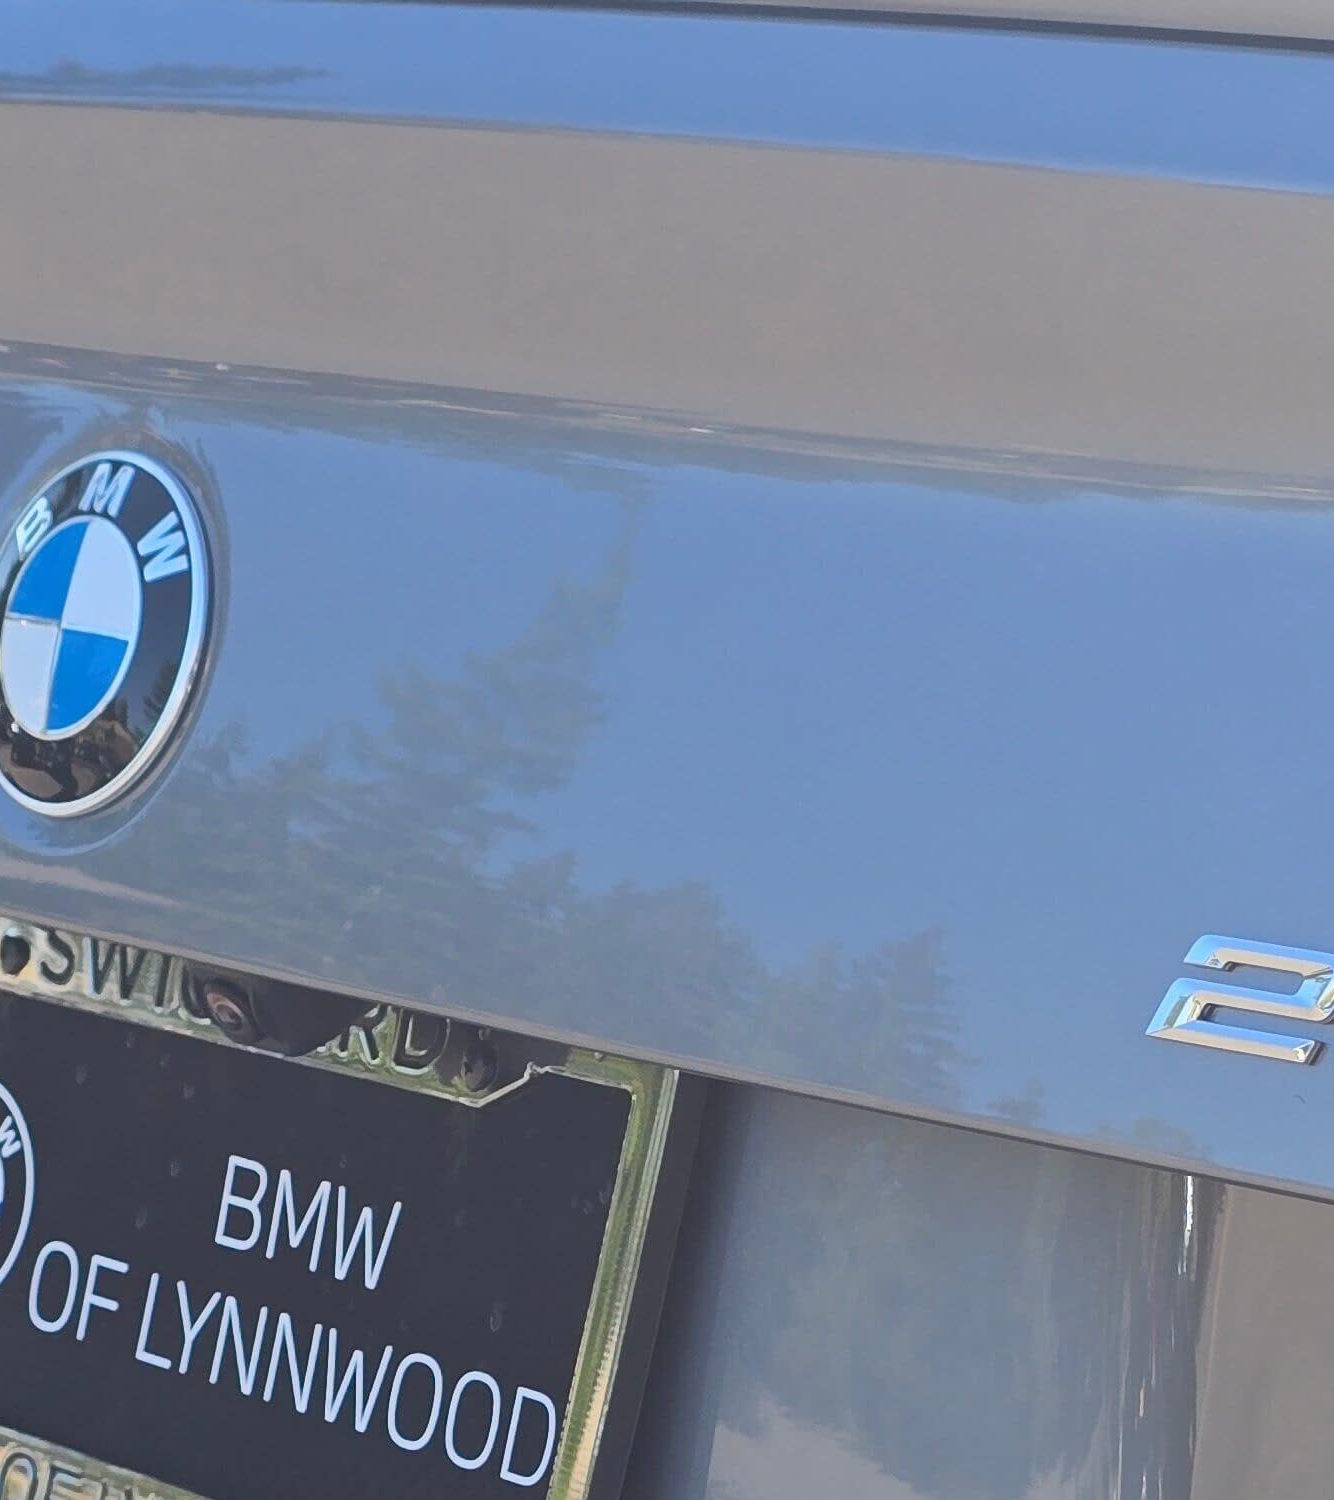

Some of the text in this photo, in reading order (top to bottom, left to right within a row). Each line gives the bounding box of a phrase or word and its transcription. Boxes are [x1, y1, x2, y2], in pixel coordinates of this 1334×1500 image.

[15, 462, 190, 583] BMW
[214, 1154, 402, 1291] BMW
[28, 1240, 558, 1488] OF LYNNWOOD
